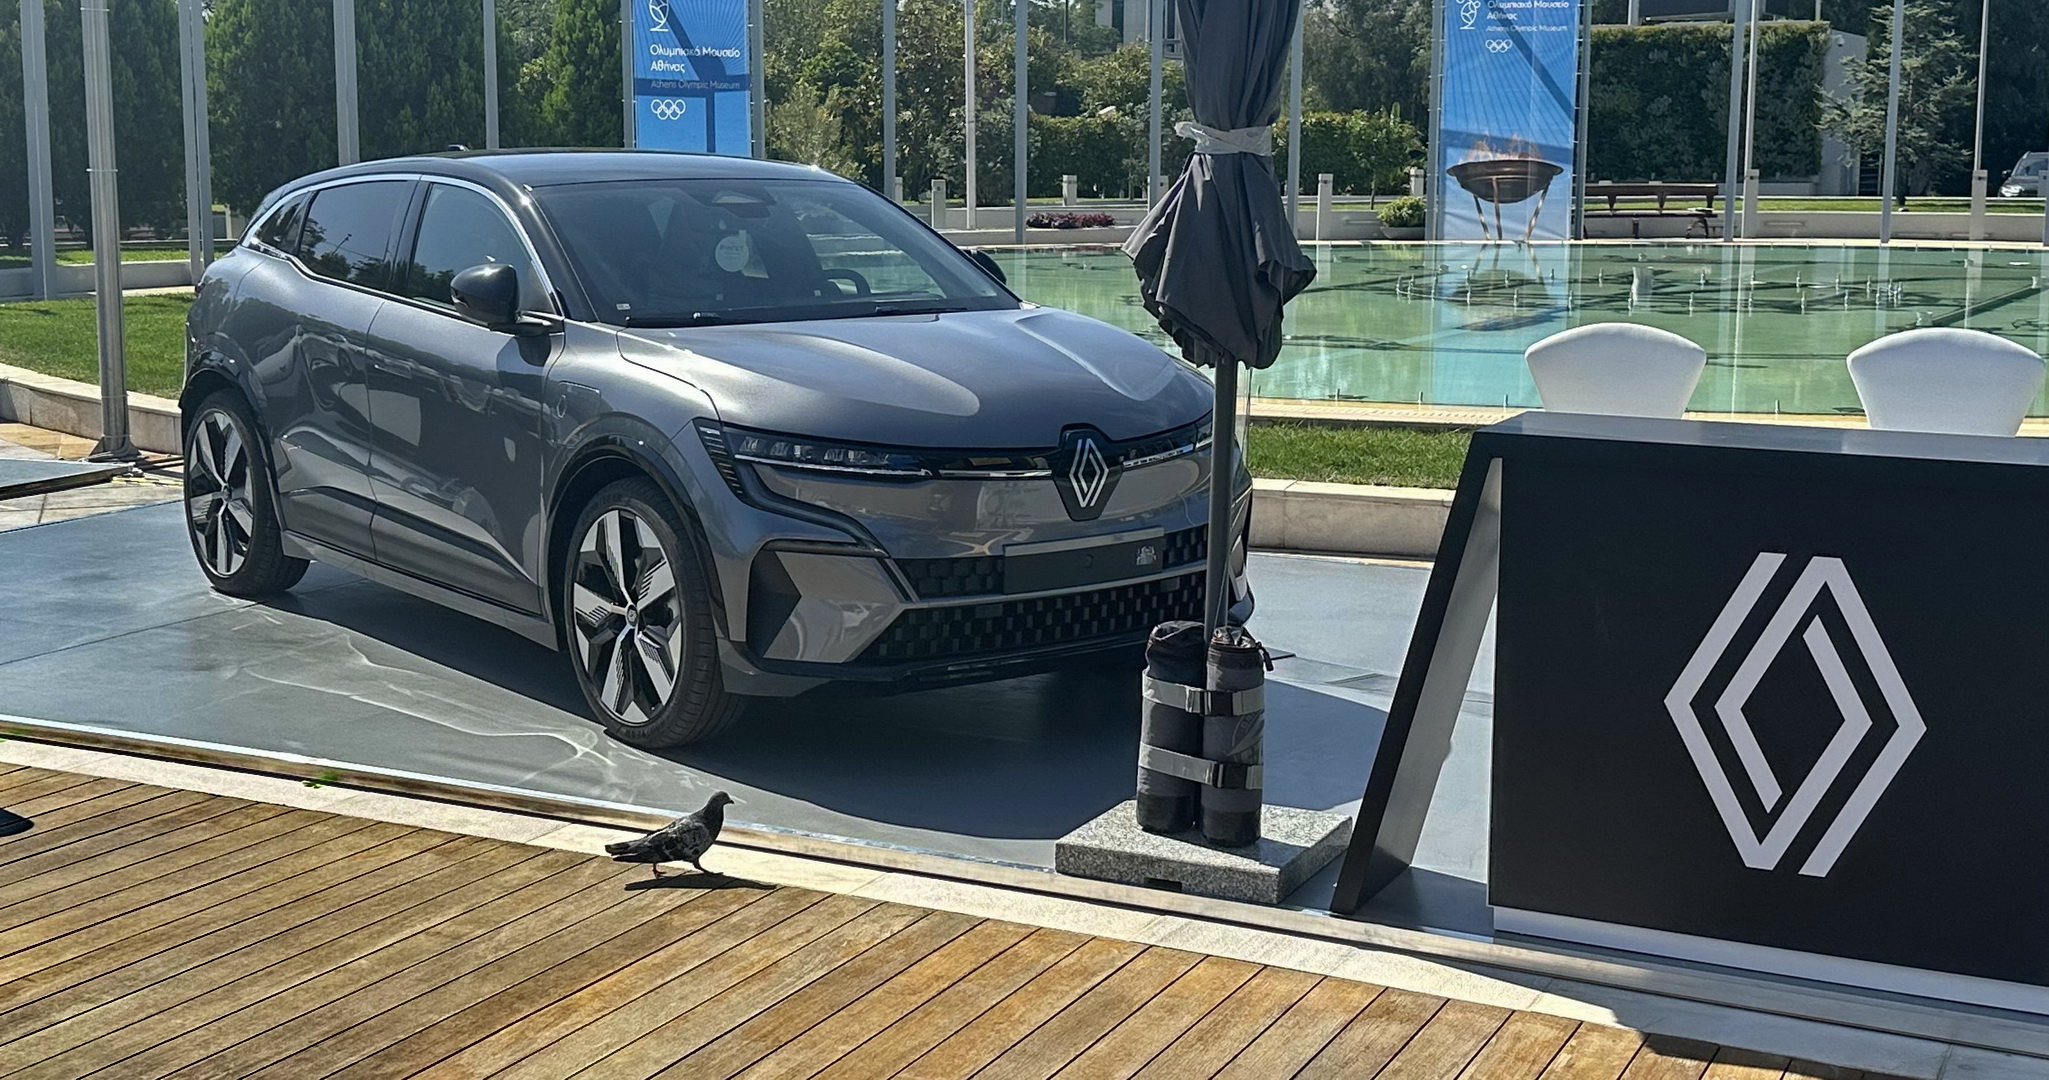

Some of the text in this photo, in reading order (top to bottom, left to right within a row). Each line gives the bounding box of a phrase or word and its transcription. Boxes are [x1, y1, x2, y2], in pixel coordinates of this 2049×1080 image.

[650, 44, 741, 58] Ολυμπιακό Μουσείο
[650, 60, 686, 73] Αθήνας
[651, 80, 677, 89] Athens
[709, 81, 741, 89] Museum
